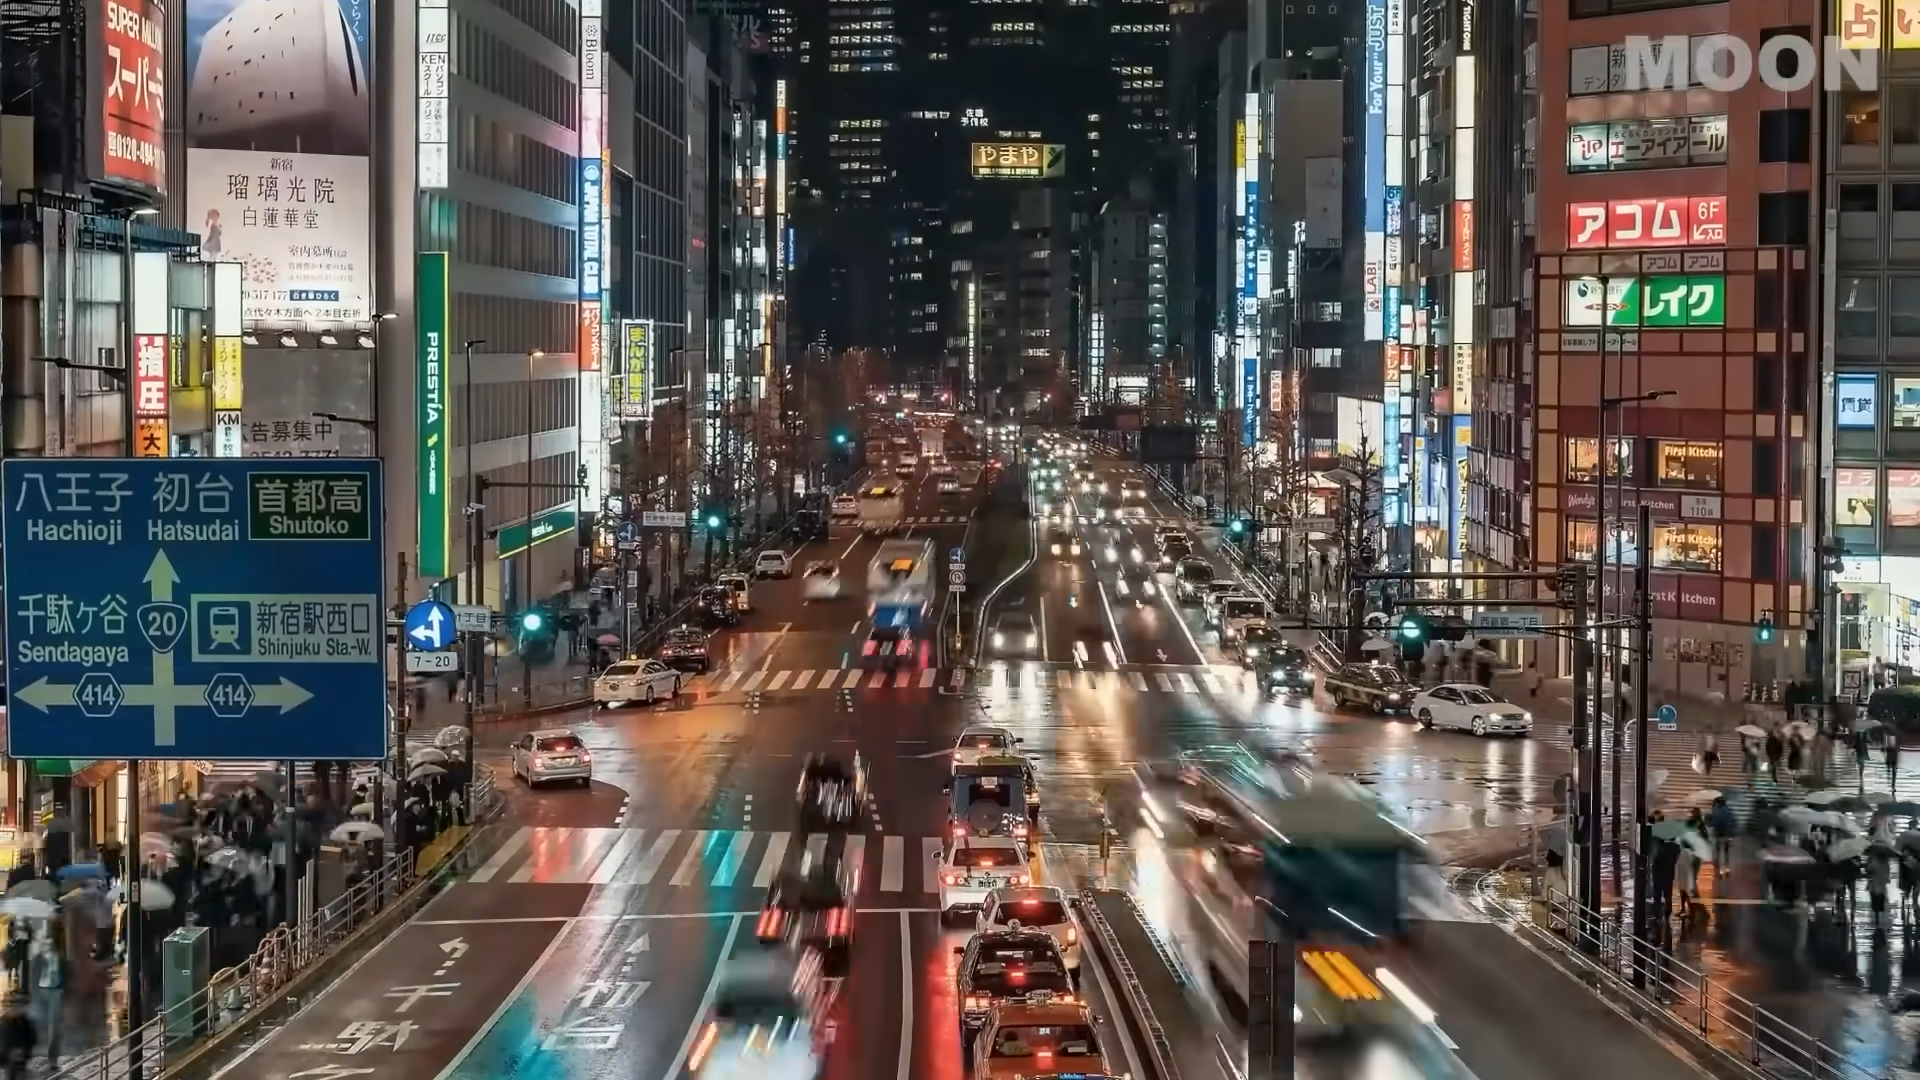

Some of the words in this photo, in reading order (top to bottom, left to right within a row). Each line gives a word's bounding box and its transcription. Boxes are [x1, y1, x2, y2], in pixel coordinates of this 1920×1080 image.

[107, 1, 140, 40] SUPER
[1368, 5, 1385, 51] JUST
[421, 54, 446, 64] KEN
[585, 39, 598, 80] Bloom
[423, 65, 432, 96] スクール
[435, 65, 444, 96] パソコン
[1369, 91, 1383, 114] For
[978, 144, 1039, 164] やまや
[1611, 133, 1725, 159] エーアイアール
[270, 157, 293, 171] 新宿
[227, 173, 335, 204] 瑠璃光院
[243, 206, 319, 229] 白蓮華堂
[1577, 202, 1681, 243] アコム
[1698, 202, 1720, 220] 6F
[584, 223, 599, 261] TOTAL
[1706, 229, 1723, 240] 入口
[1646, 256, 1678, 269] アコム
[1688, 255, 1720, 269] アコム
[1367, 262, 1376, 294] LABI
[1643, 284, 1715, 317] レイク
[1841, 396, 1873, 413] 賃貸
[217, 413, 240, 425] KM
[1665, 446, 1686, 457] First
[1688, 446, 1723, 458] Kitche
[15, 473, 133, 512] 八王子
[152, 472, 234, 513] 初台
[254, 479, 363, 514] 首都高
[27, 519, 122, 545] Hachioji
[148, 519, 240, 541] Hatsudai
[269, 515, 349, 535] Shutoko
[1665, 534, 1686, 543] First
[1688, 534, 1723, 545] Kitche
[18, 594, 129, 635] 千駄ヶ谷
[148, 613, 177, 637] 20
[256, 601, 371, 635] 新宿駅西口
[18, 640, 129, 667] Sendagaya
[258, 637, 321, 660] Shinjuku
[82, 684, 116, 706] 414
[212, 684, 247, 706] 414
